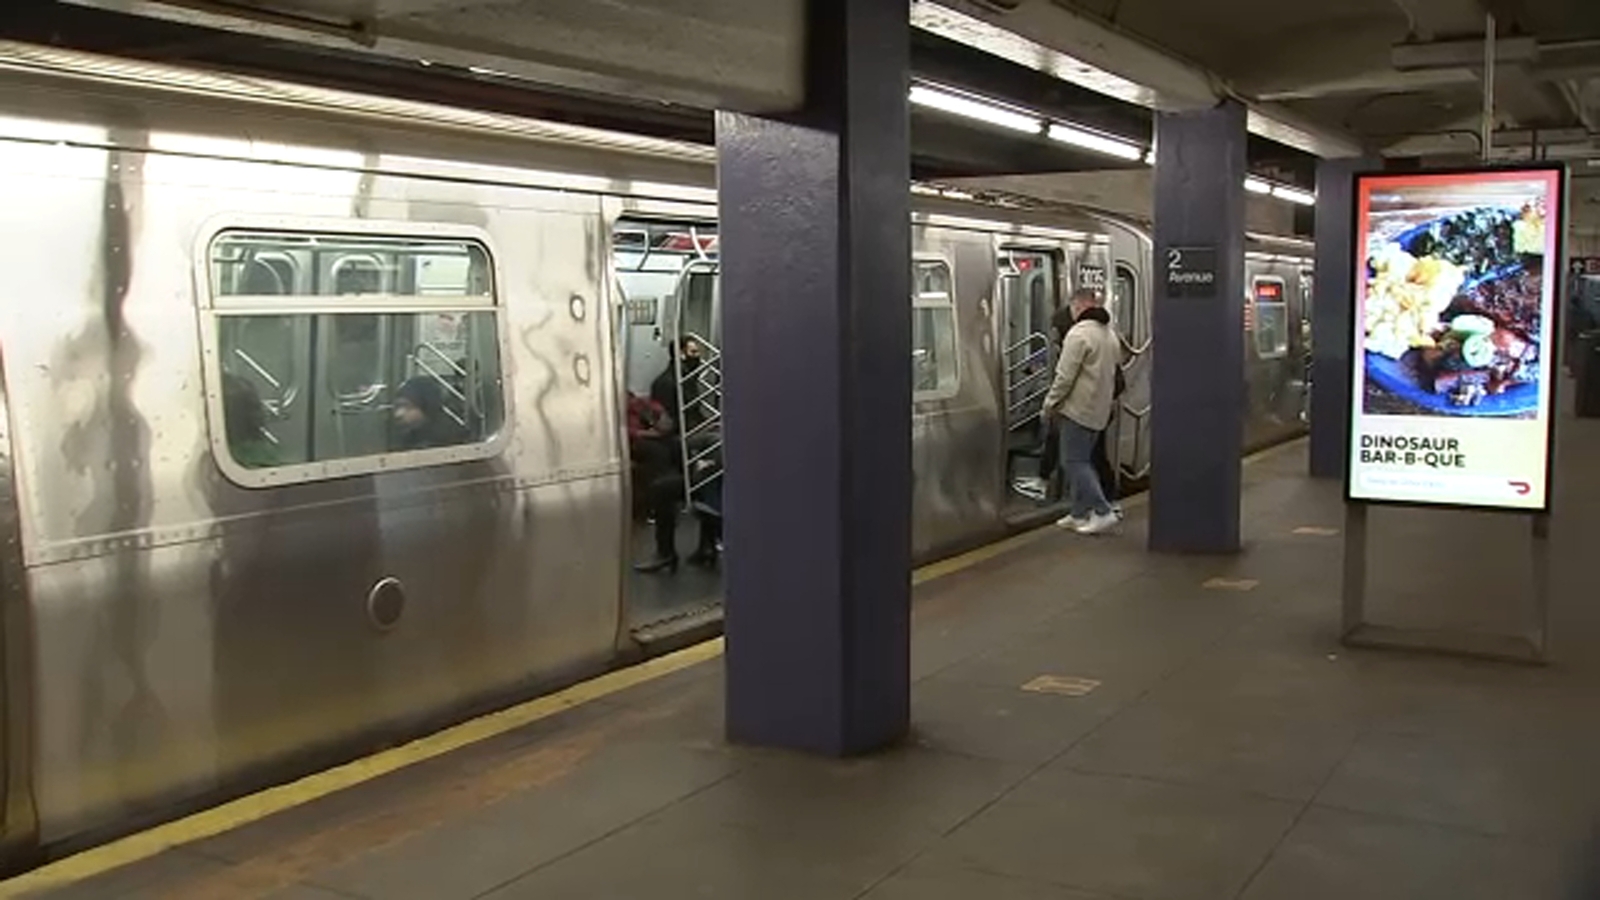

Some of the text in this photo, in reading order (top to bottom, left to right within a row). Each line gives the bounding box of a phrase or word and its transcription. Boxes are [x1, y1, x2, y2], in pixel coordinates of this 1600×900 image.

[1169, 249, 1181, 268] 2
[1169, 270, 1213, 283] Avenue
[1360, 434, 1459, 451] DINOSAUR
[1360, 449, 1465, 468] BAR-B-QUE
